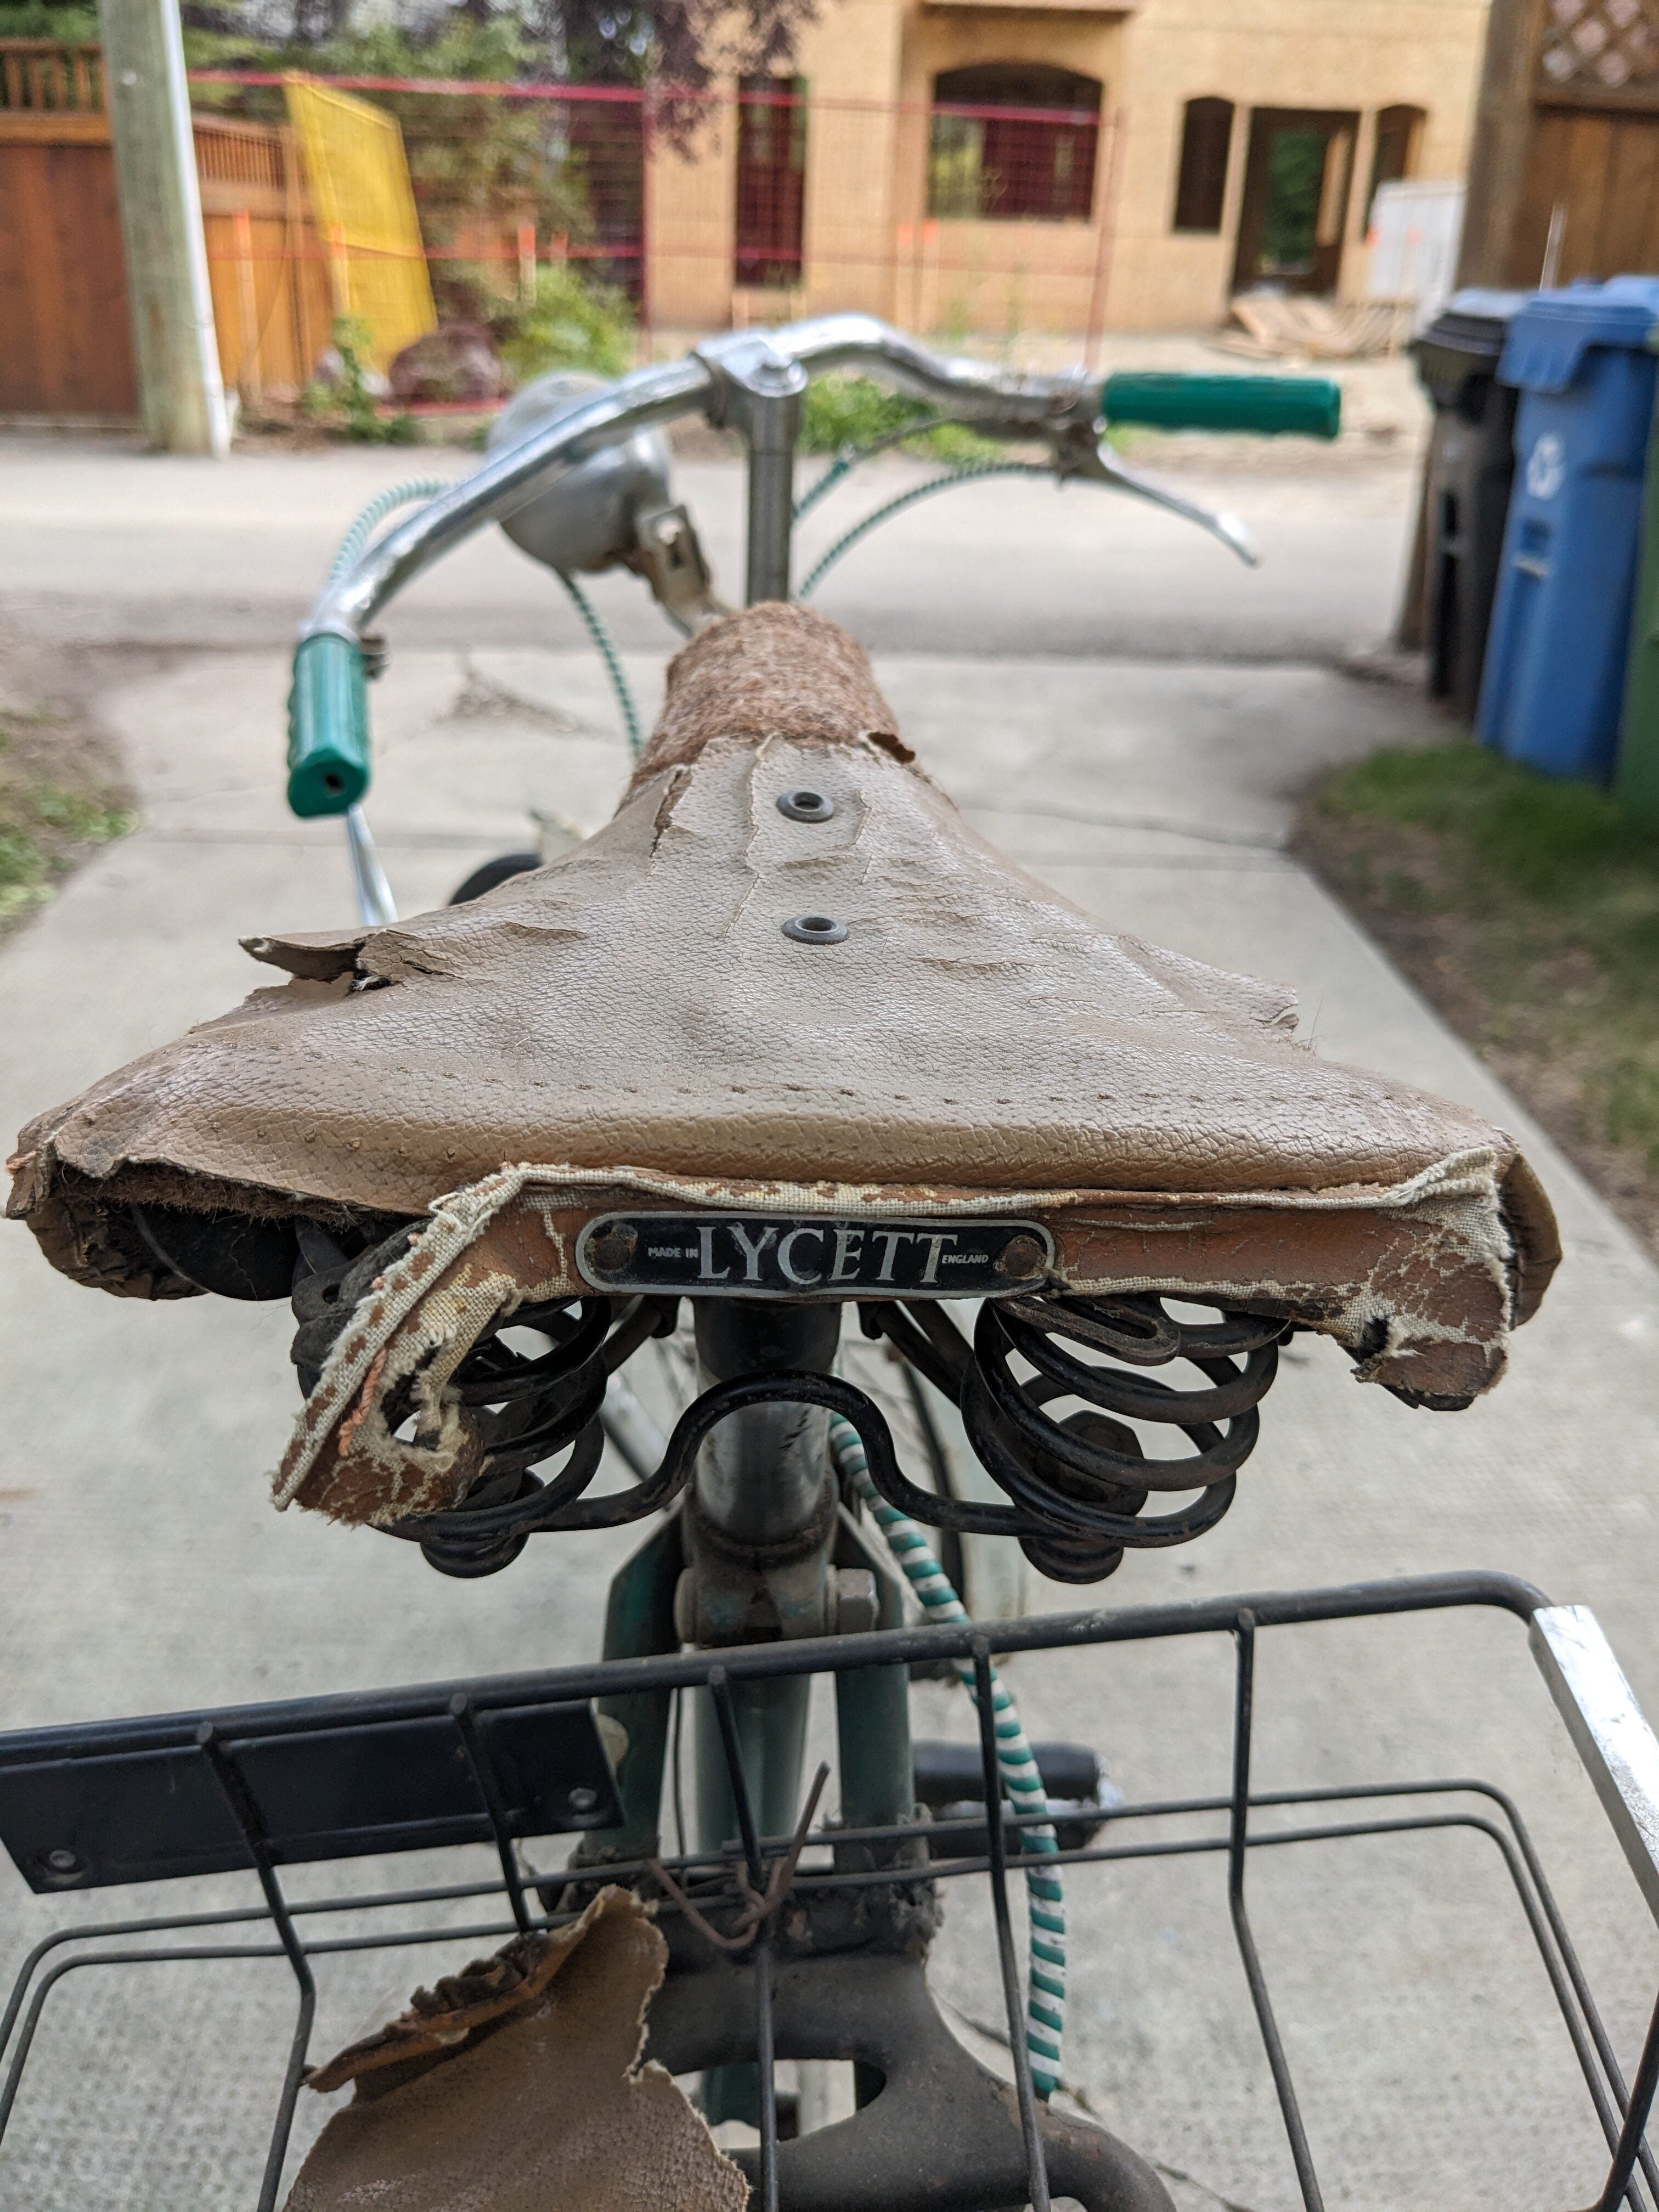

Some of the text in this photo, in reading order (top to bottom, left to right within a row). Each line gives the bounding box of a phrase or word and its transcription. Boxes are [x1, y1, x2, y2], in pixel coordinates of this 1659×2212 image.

[647, 1247, 698, 1258] MADE IN
[695, 1226, 958, 1285] LYCETT
[941, 1254, 989, 1264] ENGLAND
